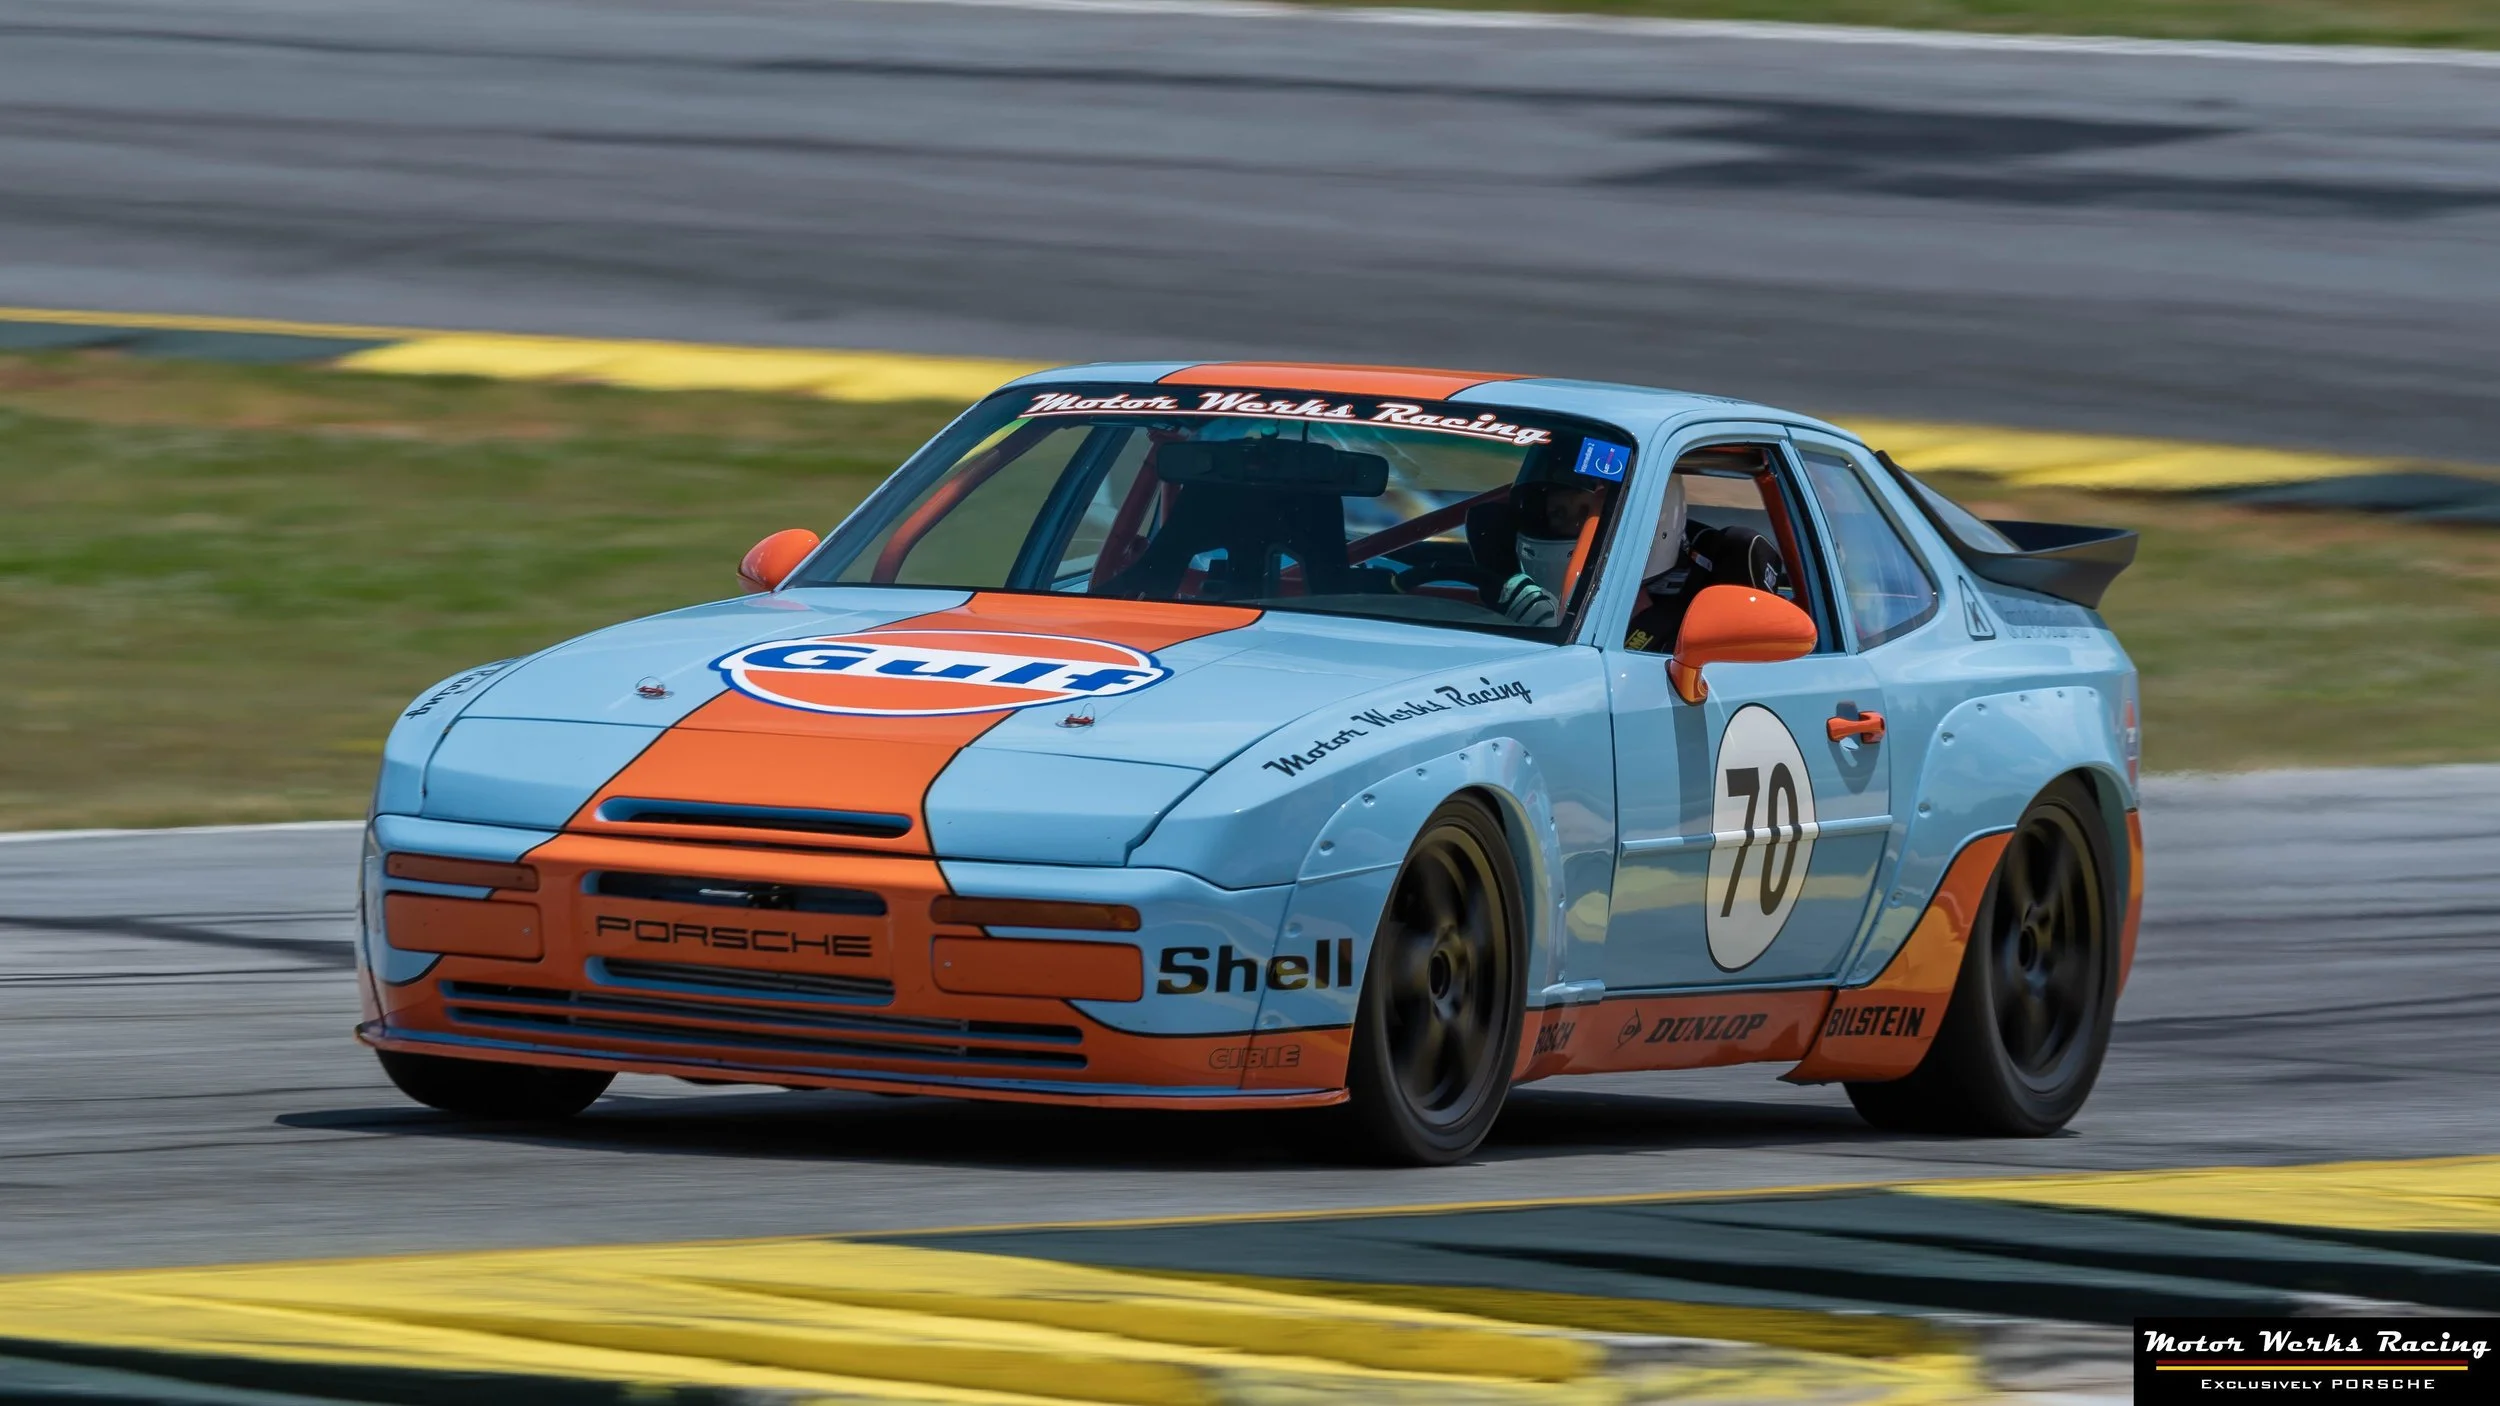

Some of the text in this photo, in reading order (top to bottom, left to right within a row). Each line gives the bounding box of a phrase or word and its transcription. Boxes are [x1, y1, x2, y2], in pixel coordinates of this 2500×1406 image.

[1026, 392, 1552, 445] Motor Werks Racing
[742, 644, 1152, 691] Gulf
[1262, 676, 1532, 777] Motor Werks Racing
[1720, 762, 1803, 918] 70
[596, 915, 872, 958] PORSCHE
[1156, 938, 1353, 995] Shell
[1644, 1013, 1769, 1044] DUNLOP
[1825, 1006, 1926, 1037] BILSTEIN
[1208, 1044, 1301, 1070] CIBIE
